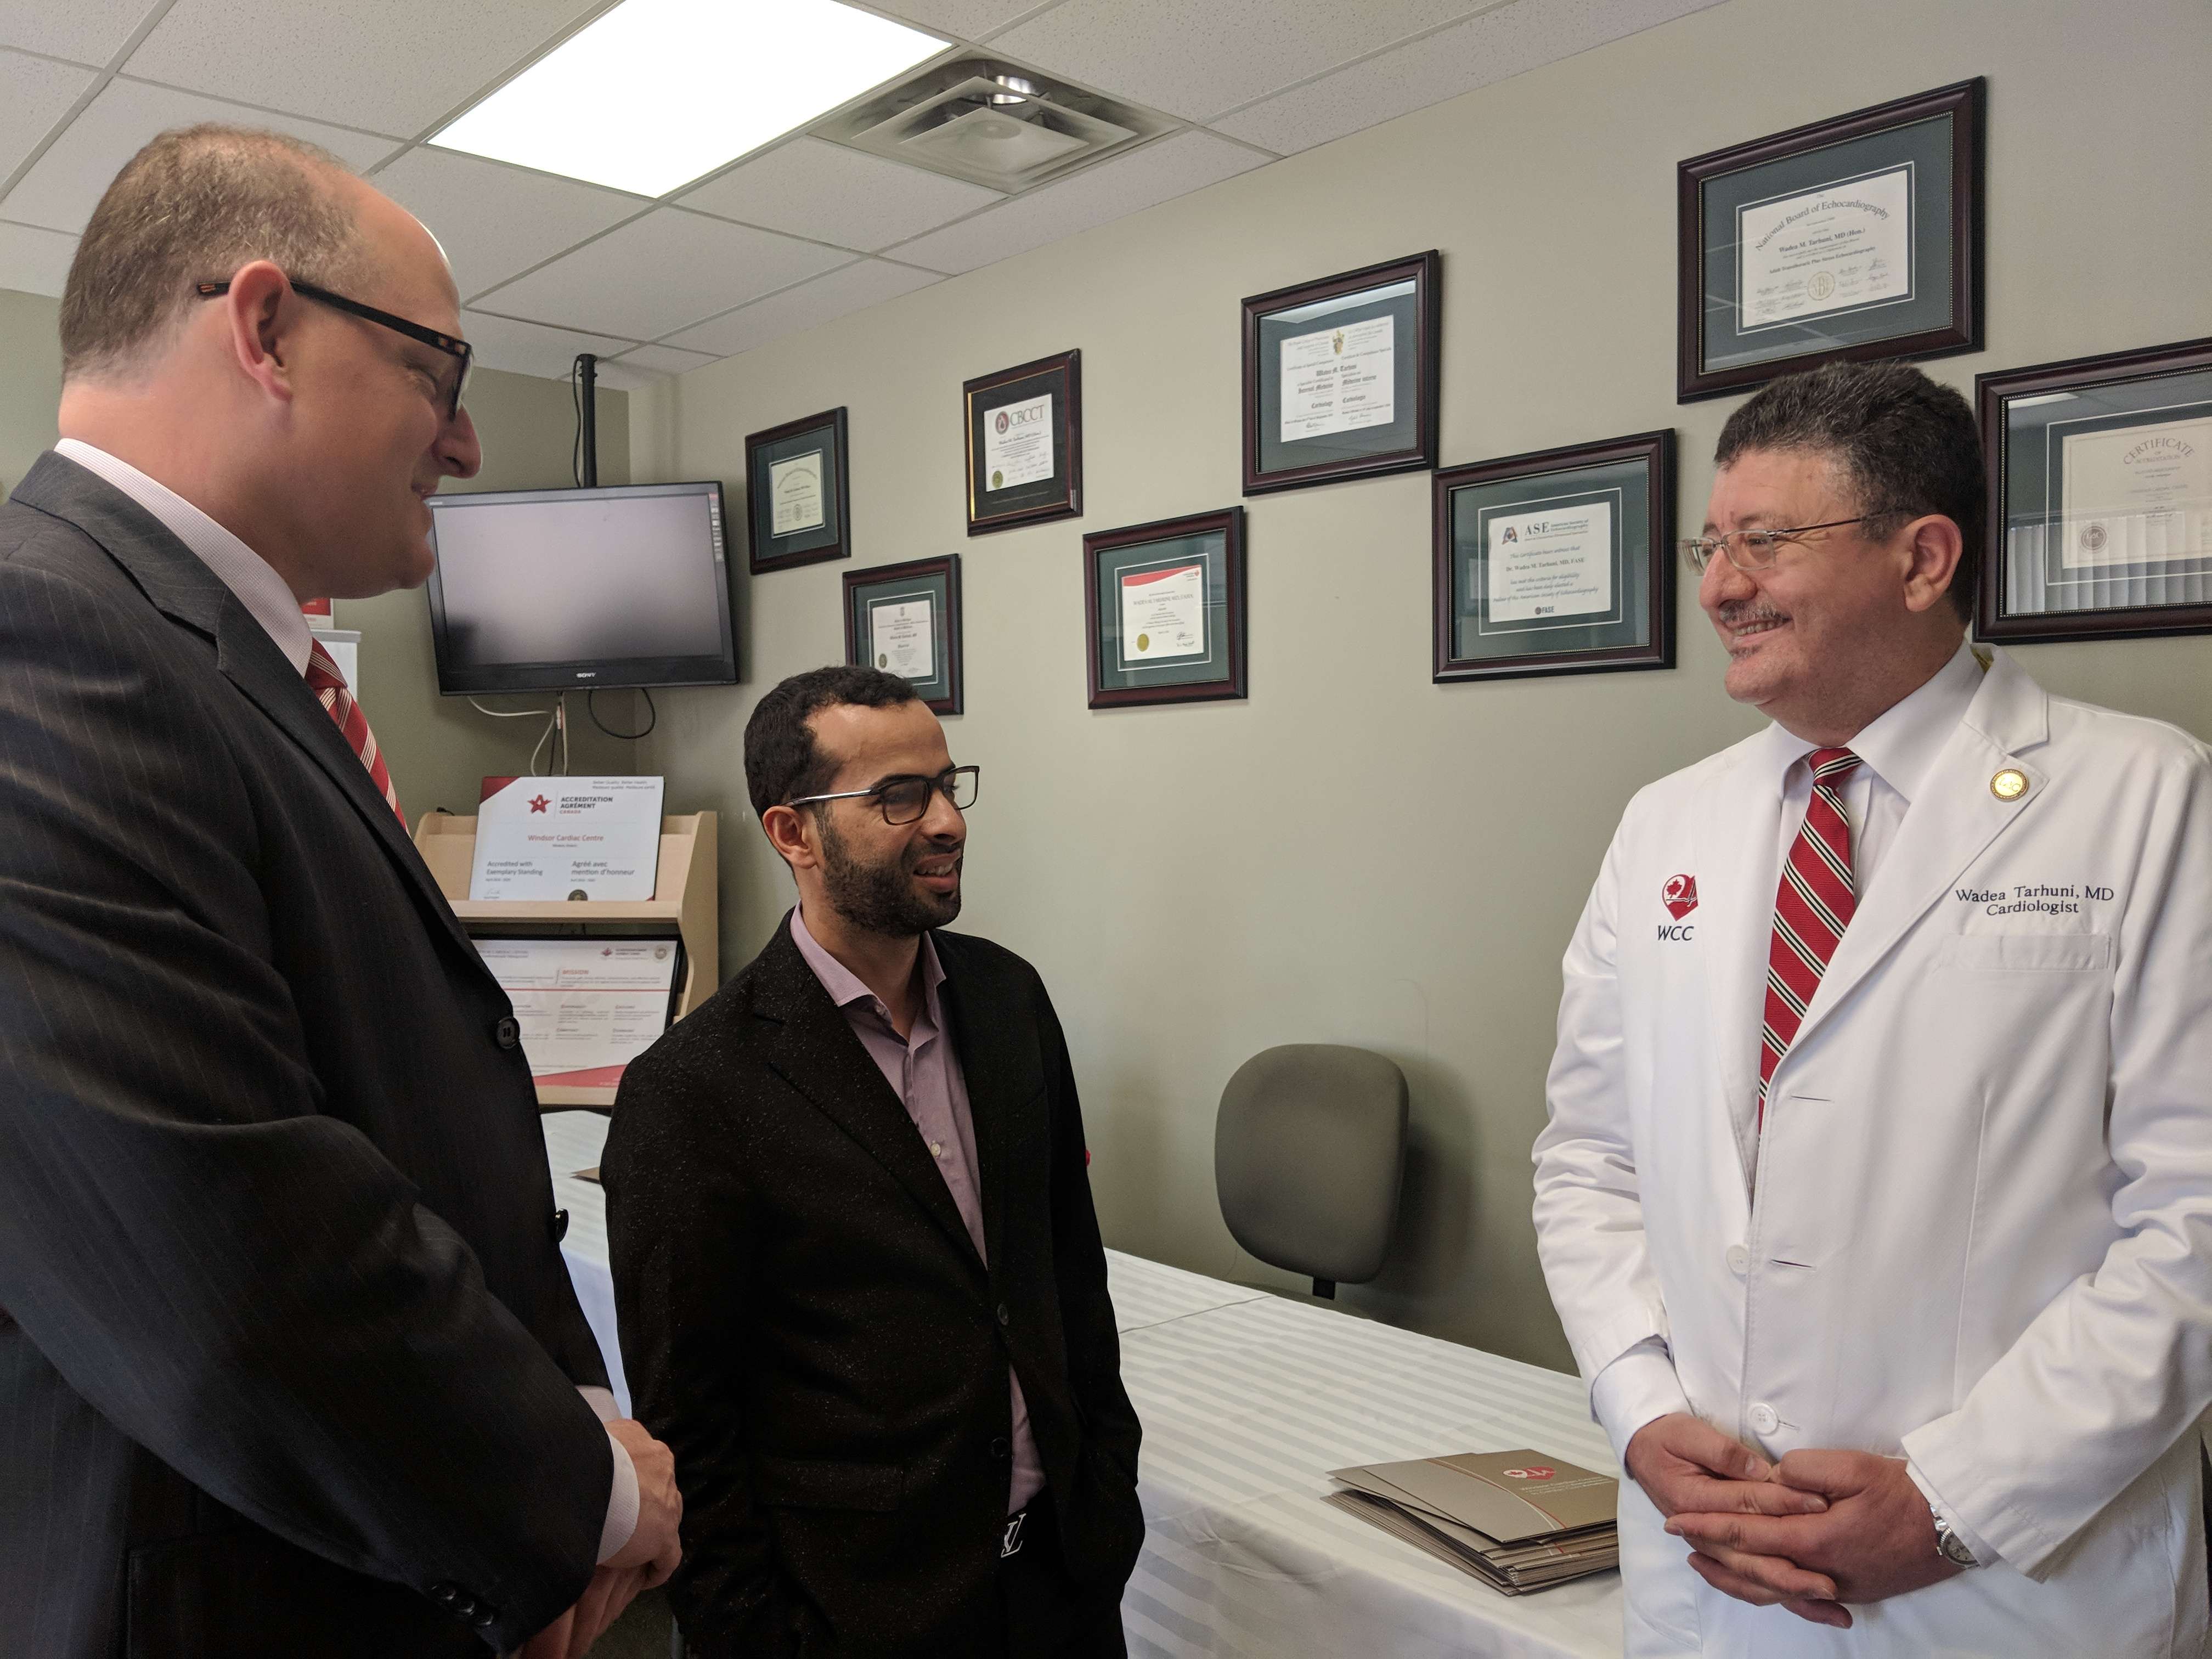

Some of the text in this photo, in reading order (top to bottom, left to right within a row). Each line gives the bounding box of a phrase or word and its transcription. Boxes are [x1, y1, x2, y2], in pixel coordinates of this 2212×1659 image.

[1756, 221, 1785, 251] National
[1786, 207, 1809, 224] Board
[1812, 202, 1821, 213] of
[1822, 199, 1891, 220] Echocardiography
[1010, 404, 1045, 426] CBCCT
[2124, 438, 2195, 465] CERTIFICATE
[1525, 521, 1550, 536] ASE
[572, 860, 592, 868] Agréé
[1955, 884, 2114, 902] Wadea Tarhuni, MD
[1987, 900, 2079, 916] Cardiologist
[1657, 925, 1695, 941] WCC
